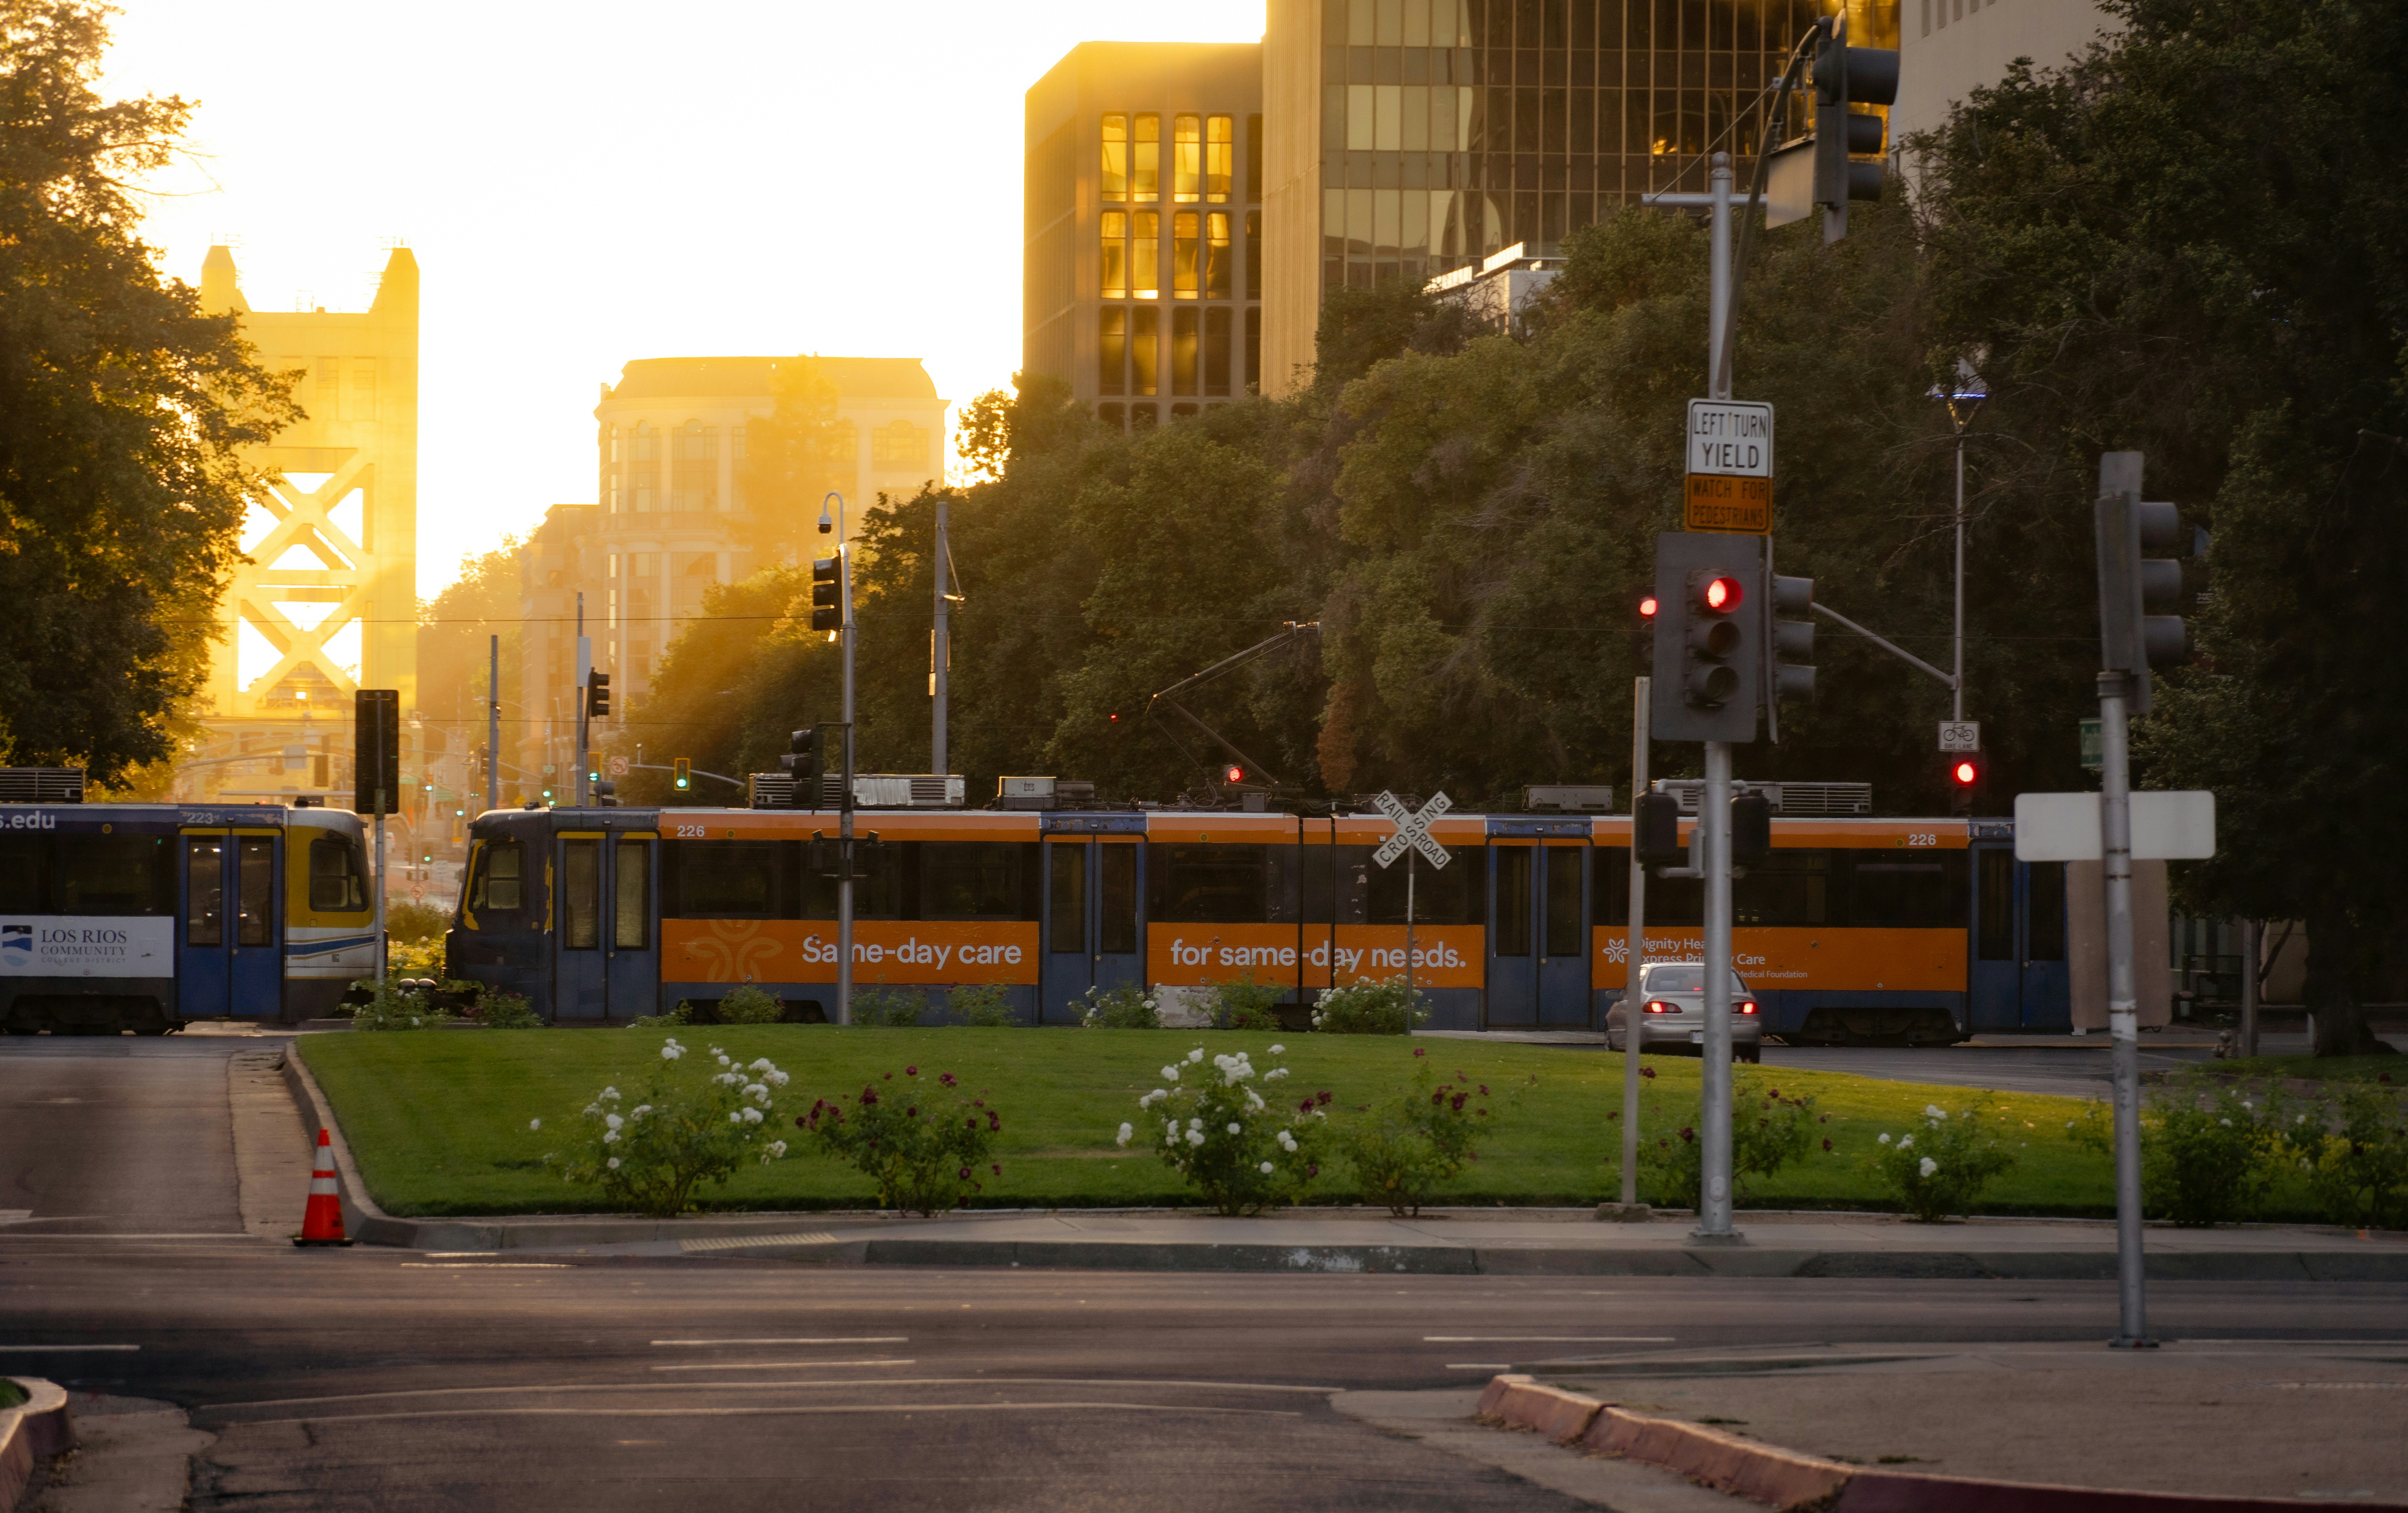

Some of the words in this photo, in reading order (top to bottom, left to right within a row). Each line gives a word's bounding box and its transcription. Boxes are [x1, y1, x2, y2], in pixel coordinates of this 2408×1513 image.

[1694, 412, 1724, 435] LEFT
[1734, 414, 1767, 438] TURN
[1703, 443, 1759, 468] YIELD
[1693, 478, 1731, 498] WATCH
[1742, 481, 1766, 500] FOR
[1693, 505, 1764, 527] PEDESTRIANS
[187, 812, 213, 824] 223
[677, 825, 705, 837] 226
[1377, 793, 1405, 825] RAIL
[1415, 833, 1447, 865] ROAD
[1379, 797, 1446, 862] CROSSING
[1909, 834, 1936, 845] 226
[41, 930, 76, 943] LOS
[82, 930, 127, 943] RIOS
[41, 946, 126, 955] COMMUNITY
[958, 945, 1022, 964] care
[1171, 939, 1212, 965] for
[1220, 940, 1364, 973] same-day
[1372, 941, 1466, 968] needs.
[1737, 953, 1765, 965] Care
